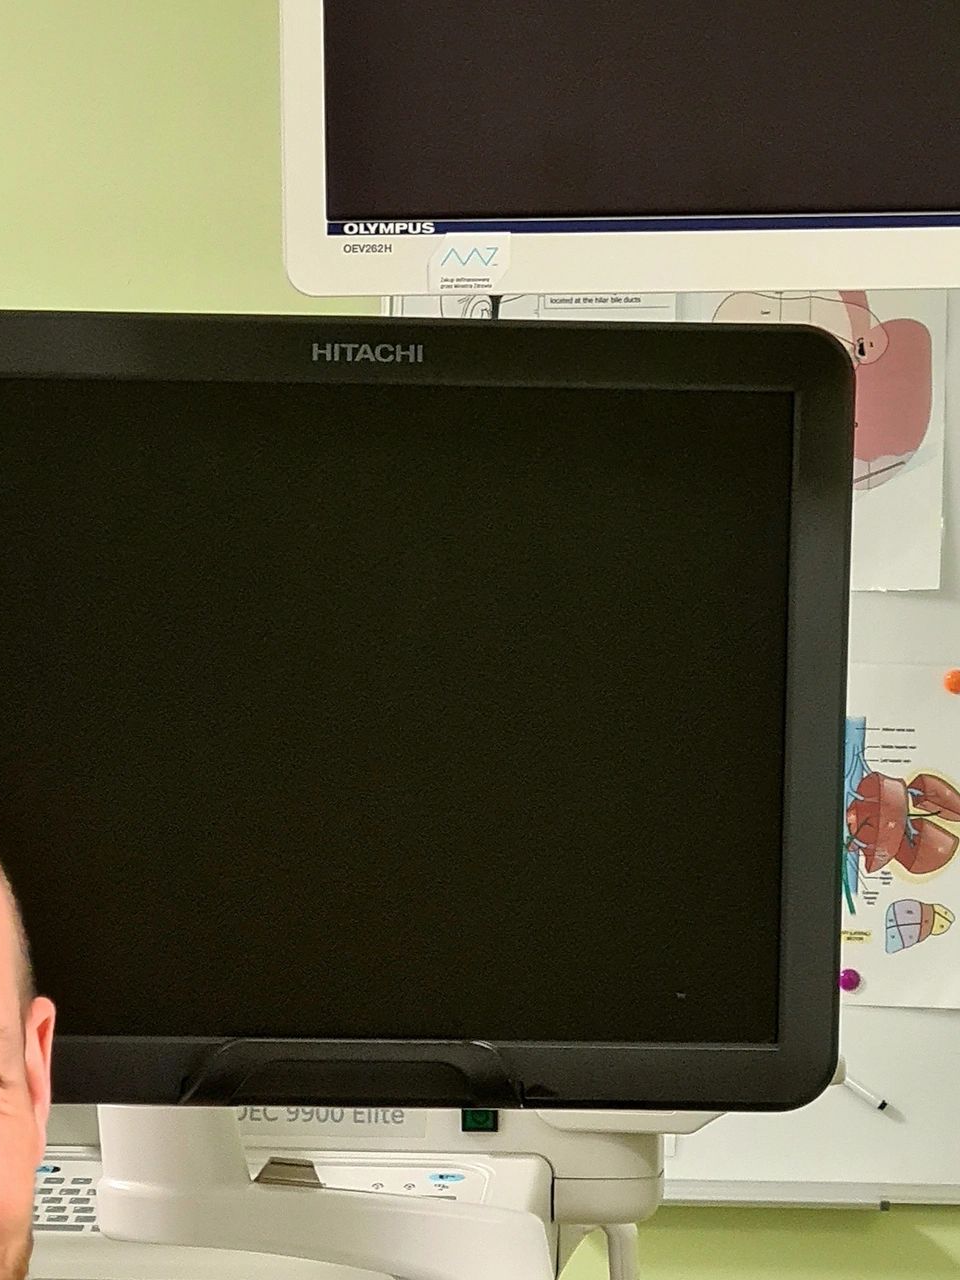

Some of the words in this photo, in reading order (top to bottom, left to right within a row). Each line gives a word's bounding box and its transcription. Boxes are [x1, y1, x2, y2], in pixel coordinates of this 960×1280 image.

[343, 222, 436, 235] OLYMPUS
[343, 244, 393, 254] OEV262H
[312, 343, 423, 362] HITACHI
[287, 1107, 344, 1123] 9900
[353, 1107, 405, 1124] Elite
